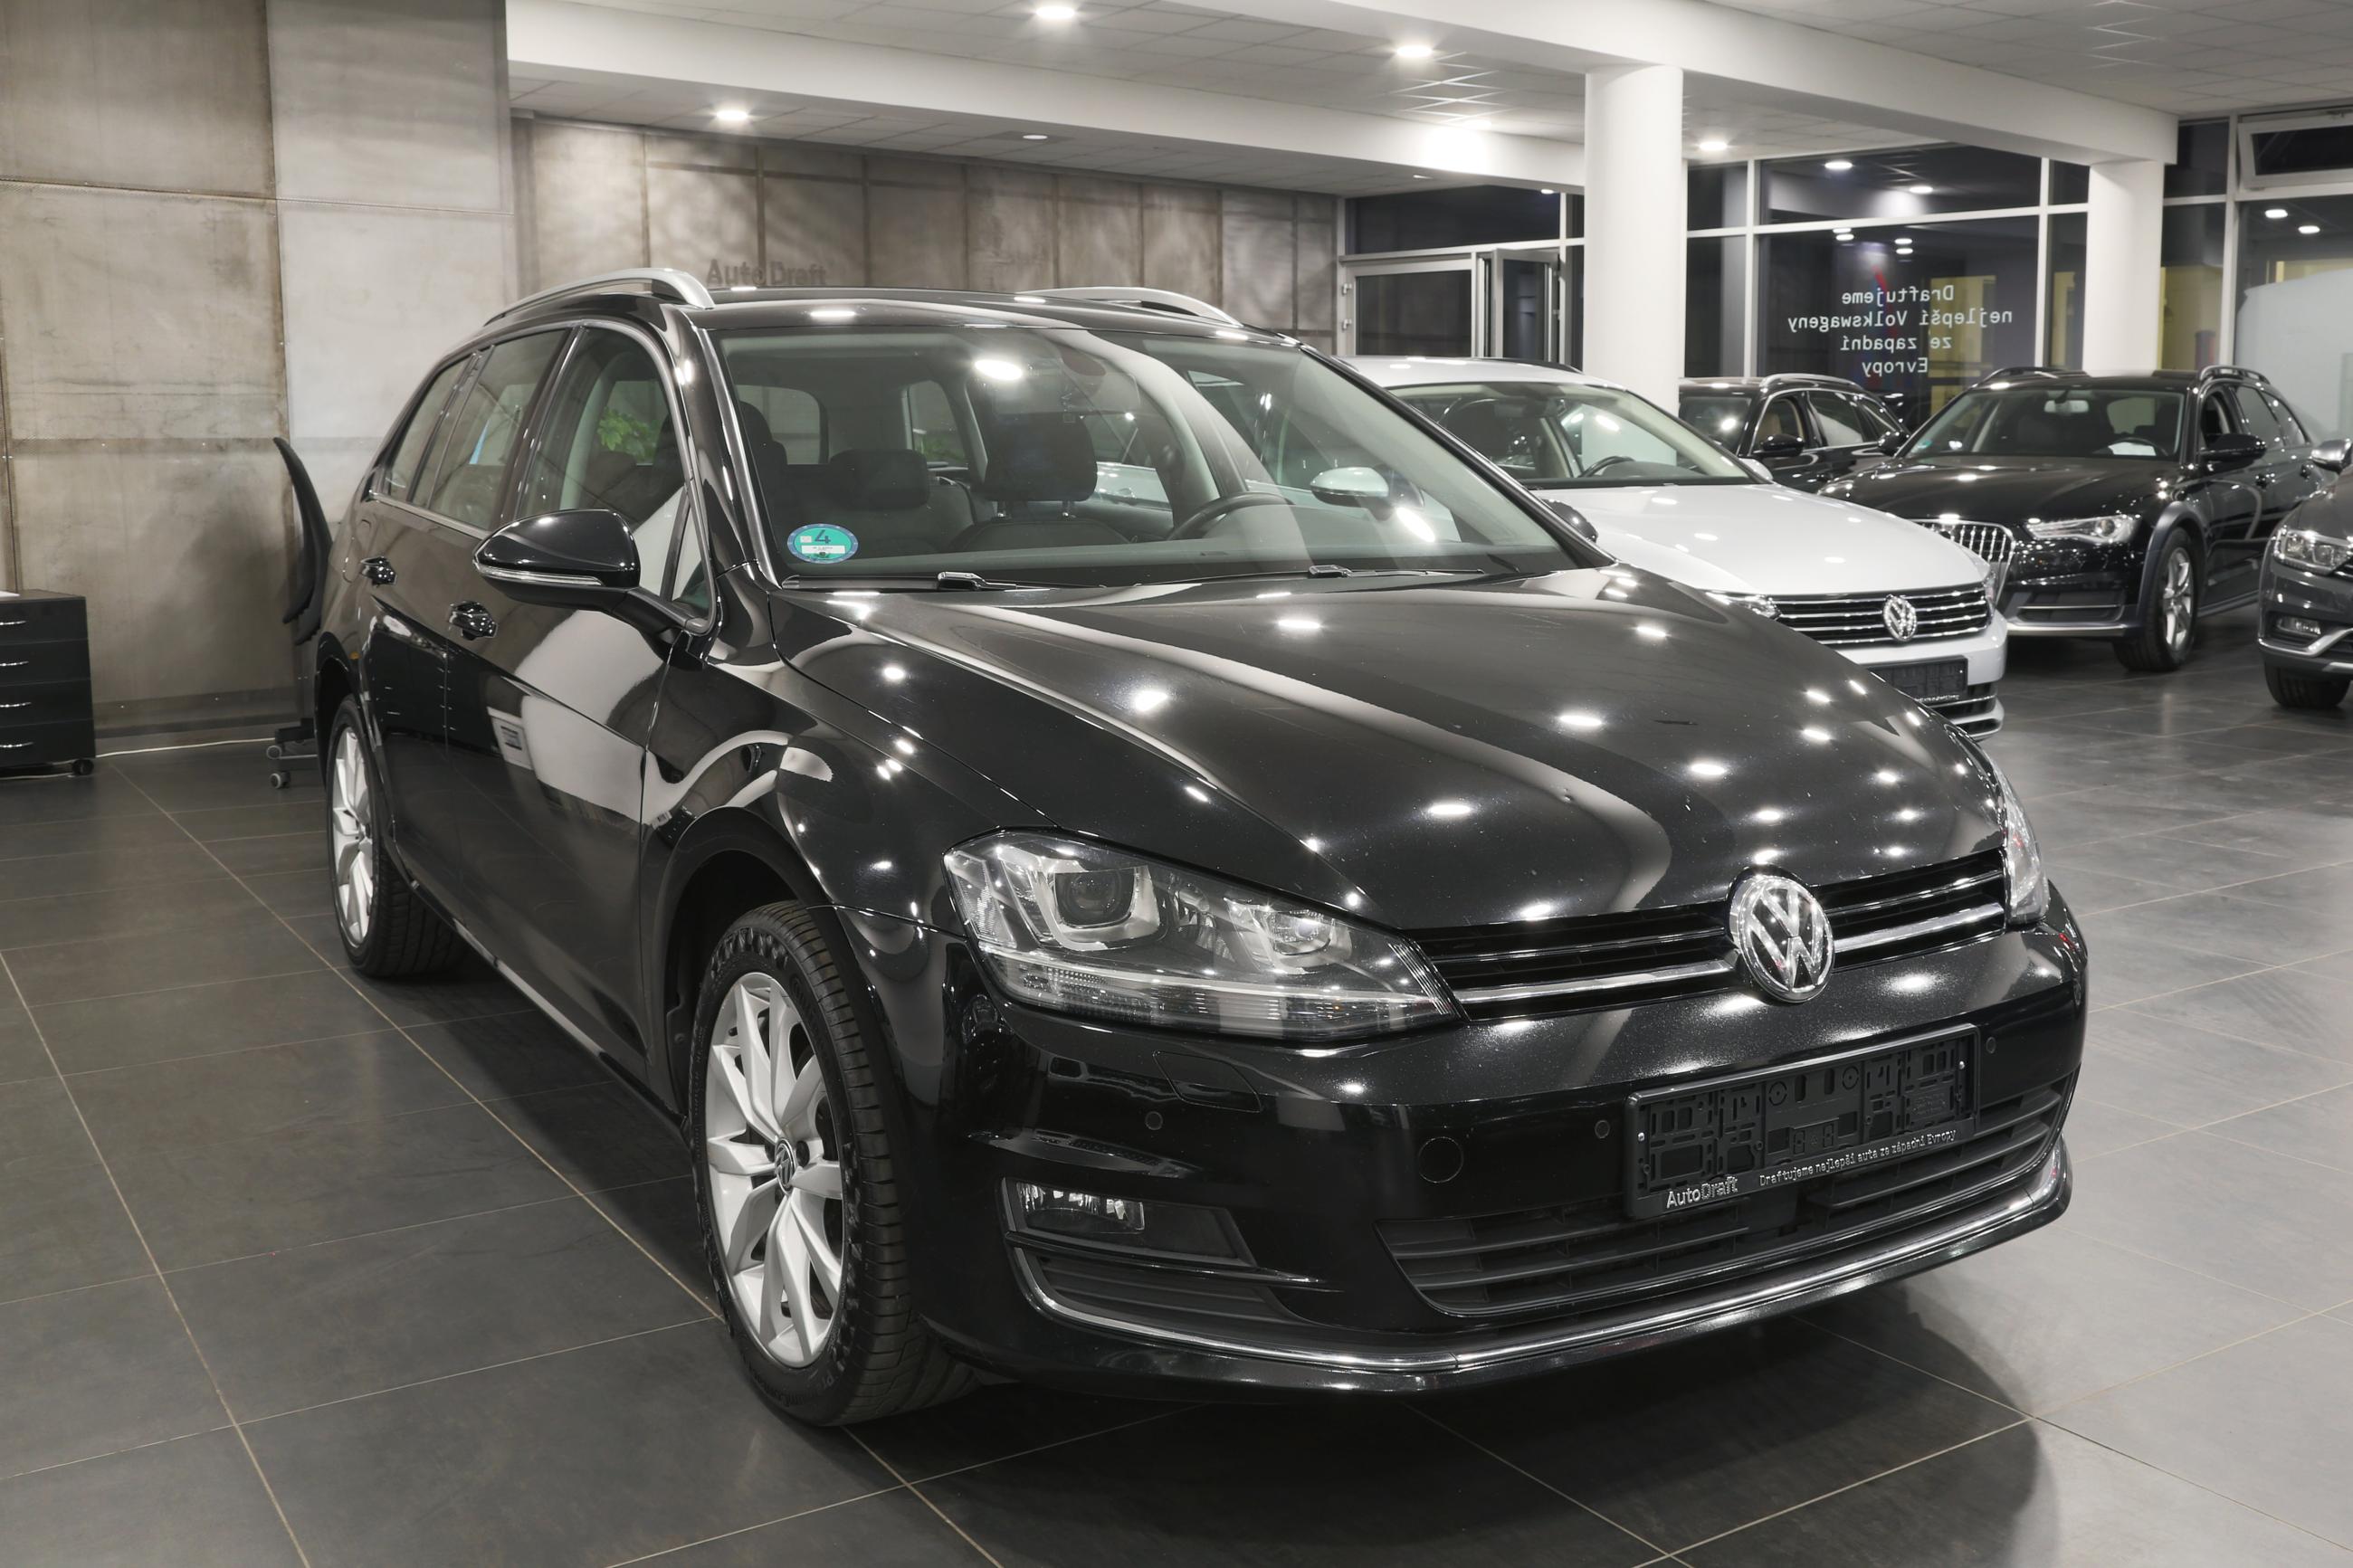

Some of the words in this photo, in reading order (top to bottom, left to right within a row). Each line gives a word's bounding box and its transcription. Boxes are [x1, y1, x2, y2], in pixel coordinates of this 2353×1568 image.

[814, 529, 831, 544] 4
[1740, 876, 1834, 1002] VW
[1759, 1165, 1813, 1186] Draftujeme
[1815, 1153, 1855, 1173] nejlepší
[1857, 1149, 1878, 1163] auta
[1927, 1130, 1957, 1145] Evropy
[1666, 1175, 1738, 1209] AutoDraft
